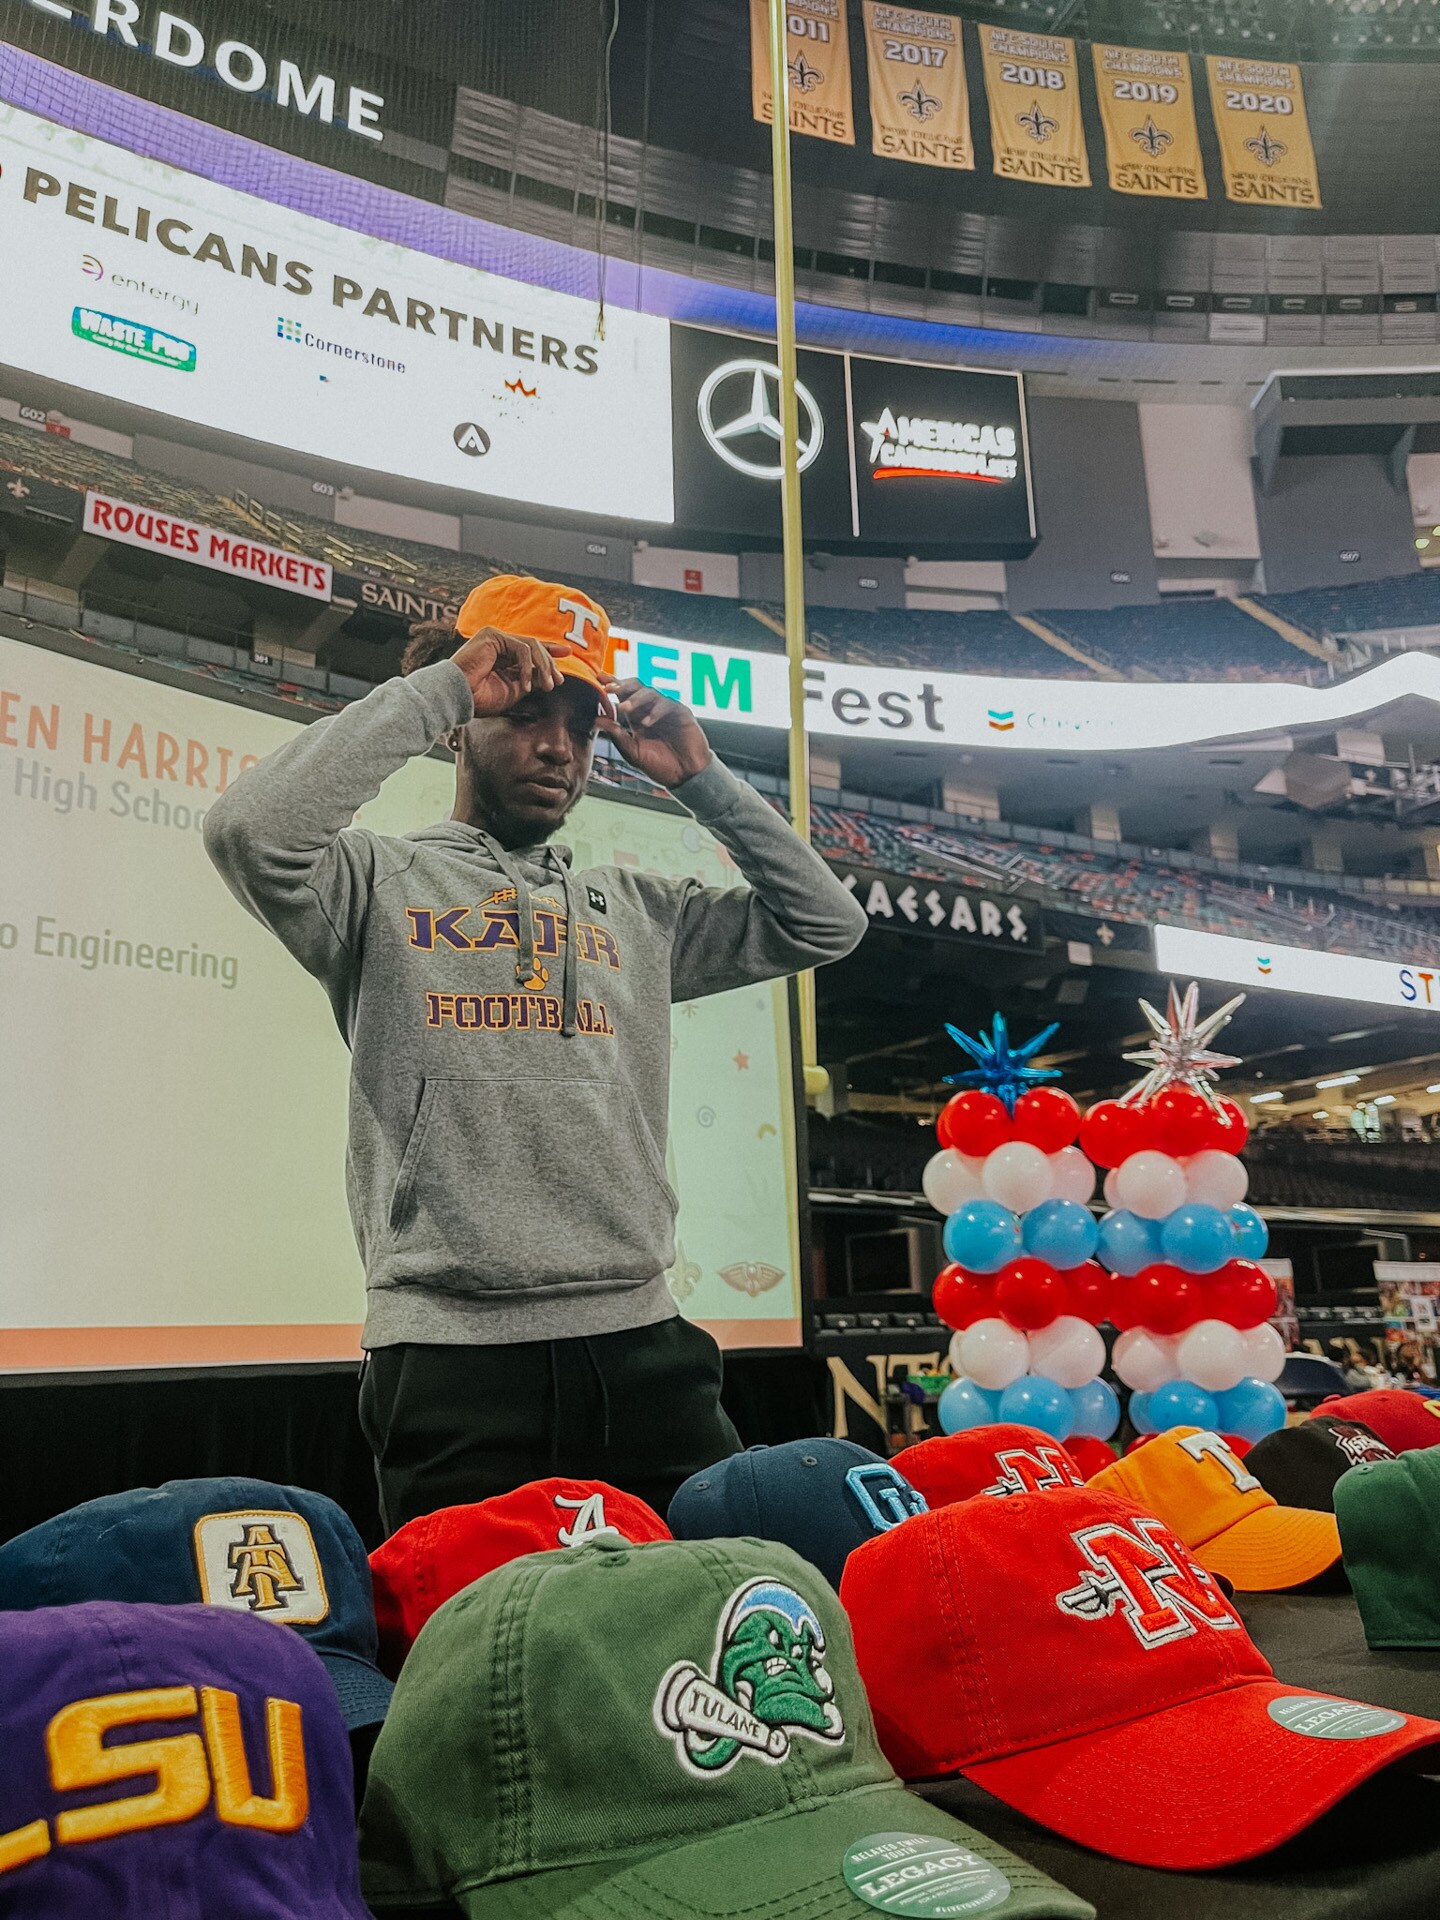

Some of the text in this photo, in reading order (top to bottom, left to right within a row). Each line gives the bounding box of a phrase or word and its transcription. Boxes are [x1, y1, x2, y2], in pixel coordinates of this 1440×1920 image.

[788, 15, 830, 43] 011
[884, 39, 947, 68] 2017
[1001, 62, 1065, 90] 2018
[1113, 79, 1178, 105] 2019
[1225, 90, 1293, 115] 2020
[882, 135, 967, 163] SAINTS
[1001, 157, 1085, 183] SAINTS
[1116, 173, 1199, 195] SAINTS
[1233, 182, 1314, 204] SAINTS
[23, 166, 600, 376] PELICANS PARTNERS
[111, 274, 199, 315] entergy
[305, 332, 406, 374] Cornerstone
[21, 406, 46, 421] 602
[312, 482, 334, 496] 603
[92, 499, 326, 592] ROUSES MARKETS
[361, 582, 459, 622] SAINTS
[558, 597, 600, 650] T
[14, 757, 205, 834] High Scho
[843, 873, 1028, 942] AESARS
[34, 915, 239, 990] Engineering
[405, 905, 622, 971] KARR
[1399, 969, 1440, 1004] ST
[689, 1688, 761, 1738] TULANE
[851, 1842, 897, 1863] RELAXED
[860, 1854, 982, 1898] LEGACY
